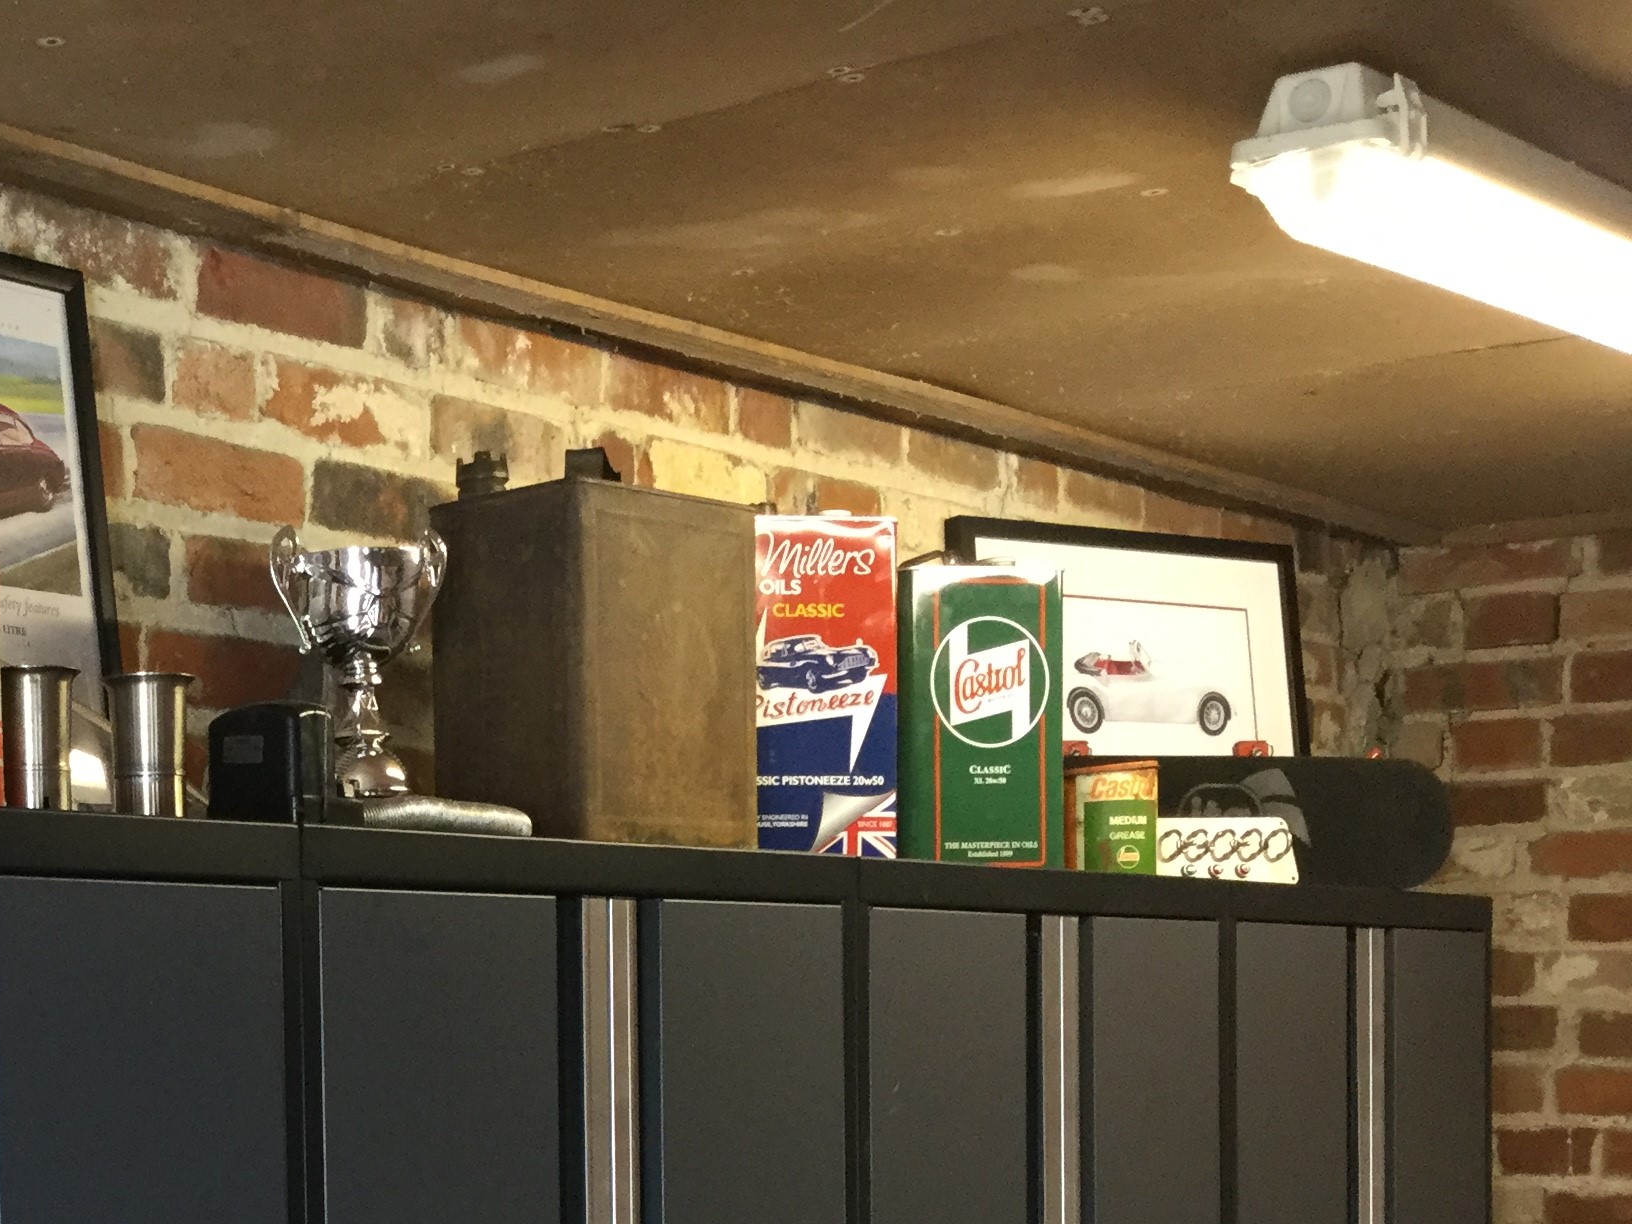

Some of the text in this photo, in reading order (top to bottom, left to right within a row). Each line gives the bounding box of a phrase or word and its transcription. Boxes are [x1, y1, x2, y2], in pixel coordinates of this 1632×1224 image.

[757, 532, 875, 578] Millers
[758, 579, 802, 595] OILS
[772, 602, 845, 618] CLASSIC
[955, 647, 1026, 714] Castrol
[756, 775, 885, 786] SSIC PISTONEEZE 20w50
[1109, 831, 1146, 840] GREASE
